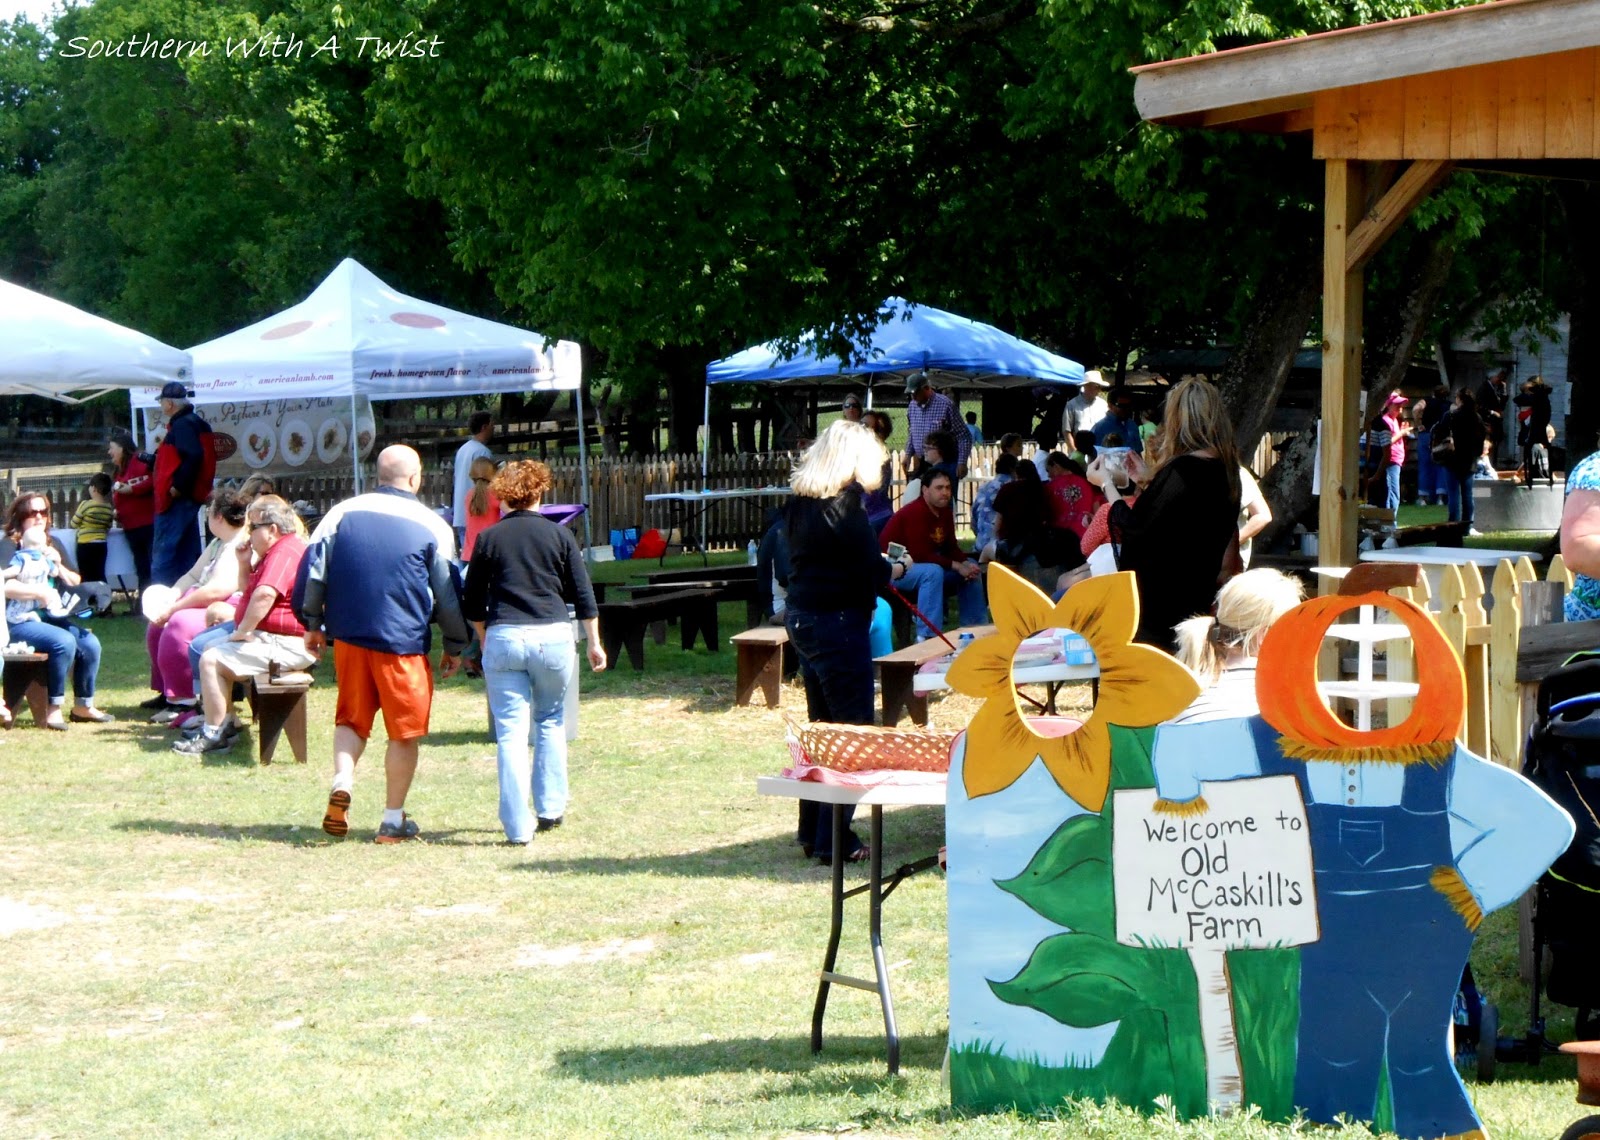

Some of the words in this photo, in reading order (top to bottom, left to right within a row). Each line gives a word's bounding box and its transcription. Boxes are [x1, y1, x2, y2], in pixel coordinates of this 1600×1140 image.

[257, 373, 335, 385] americanlamb.com
[397, 367, 445, 378] homegrown
[1142, 816, 1258, 843] Welcome
[1274, 809, 1302, 832] to
[1180, 839, 1229, 877] Old
[1147, 870, 1303, 914] McCaskill's
[1186, 911, 1263, 942] Farm
